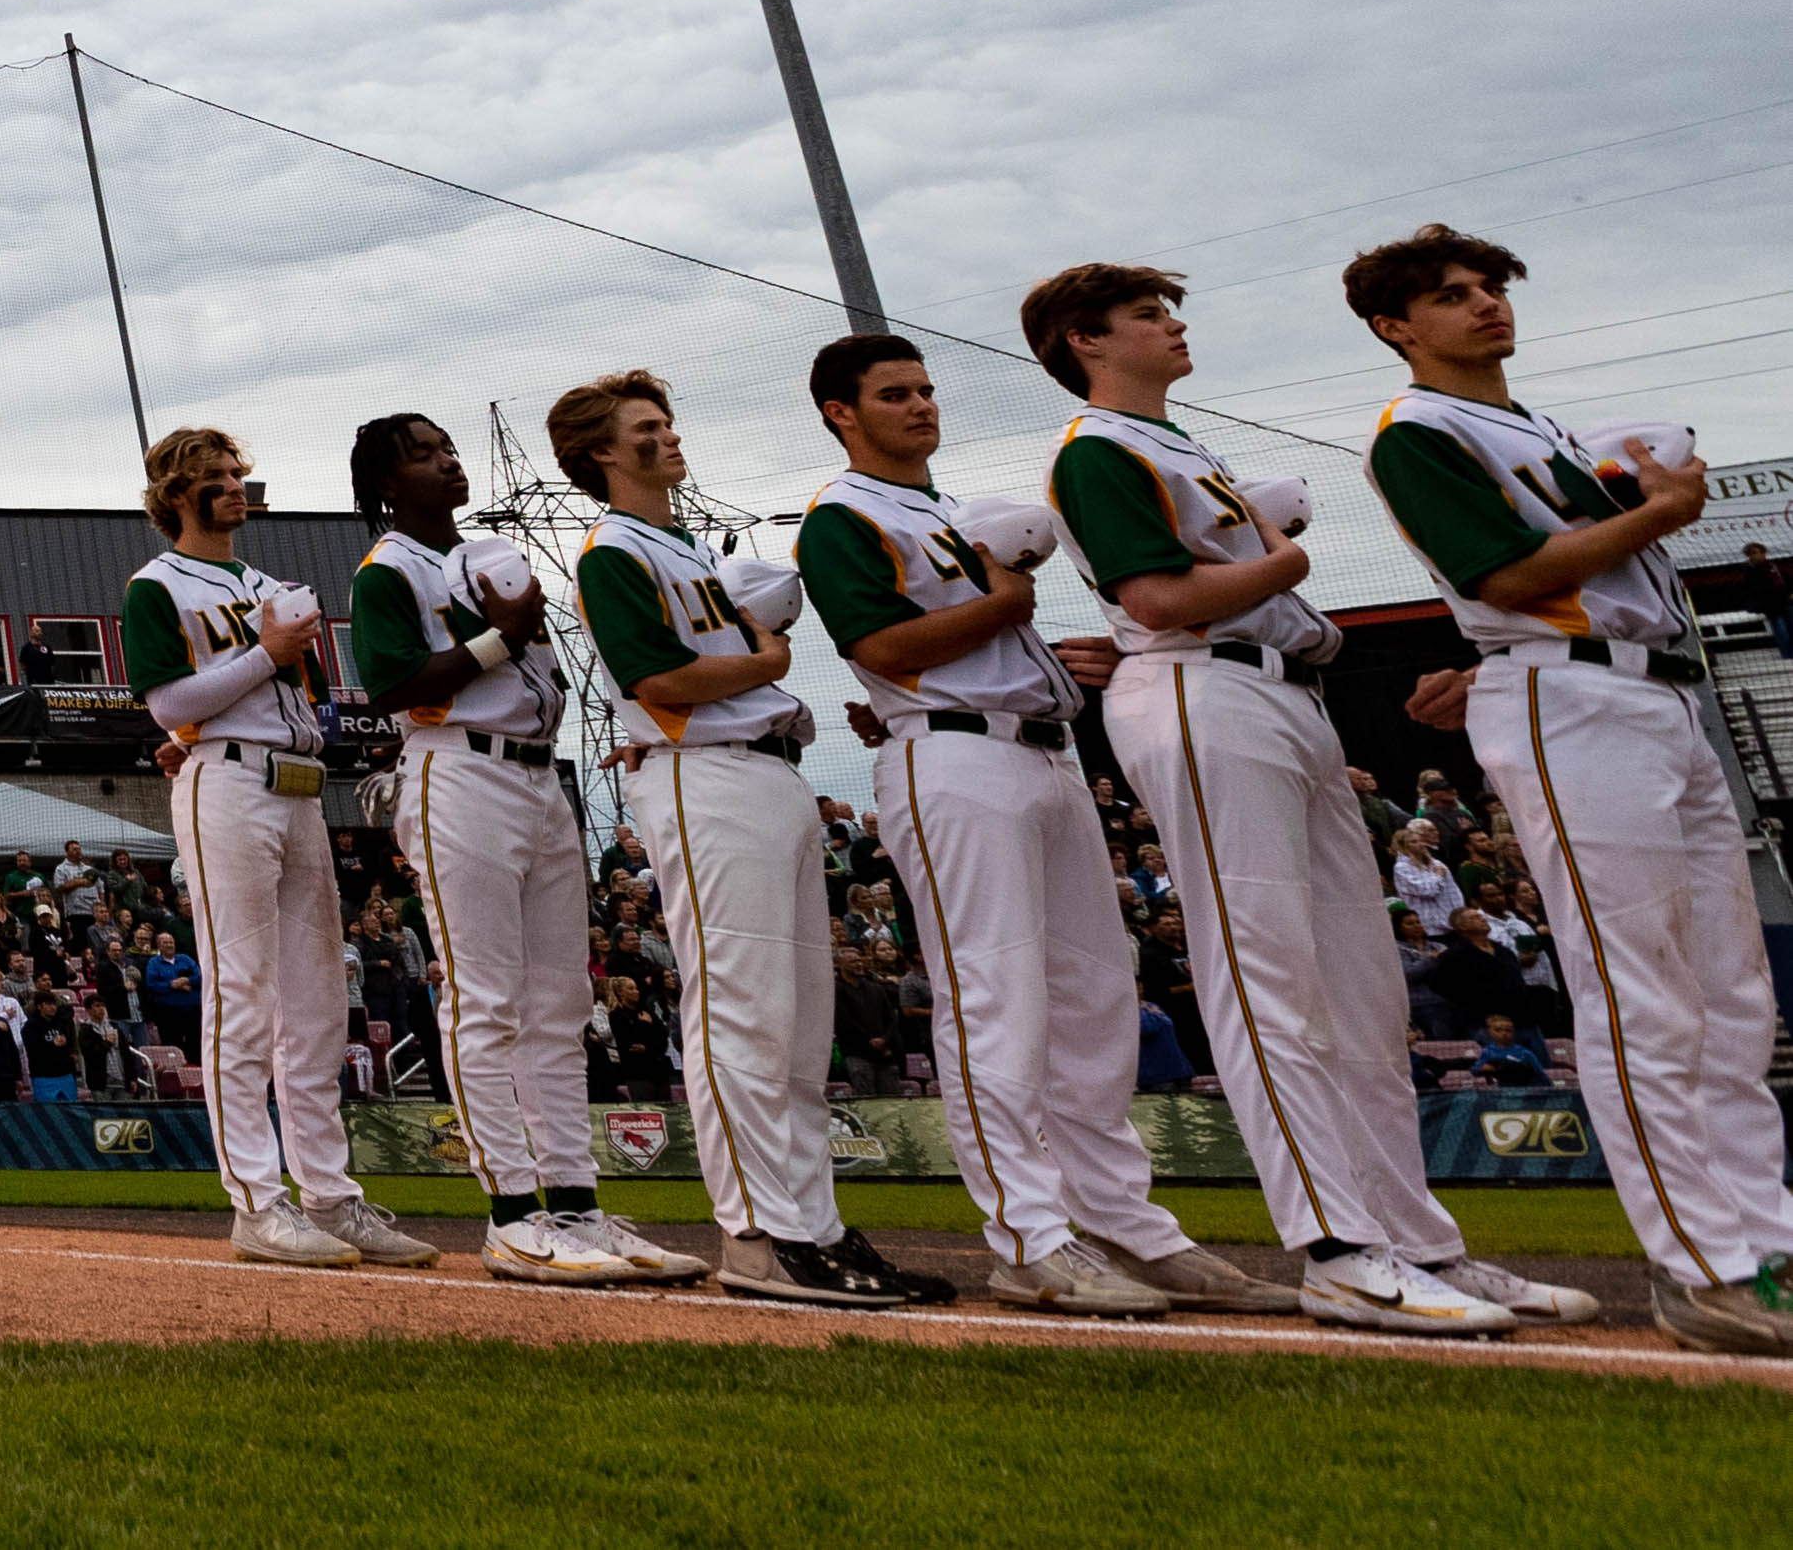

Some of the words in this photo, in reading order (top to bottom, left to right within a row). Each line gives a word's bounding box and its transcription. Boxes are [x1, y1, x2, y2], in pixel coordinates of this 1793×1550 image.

[44, 690, 72, 698] JOIN
[73, 690, 99, 699] THE
[46, 698, 91, 708] MAKES
[93, 699, 103, 709] A
[609, 1118, 661, 1129] Mavericks
